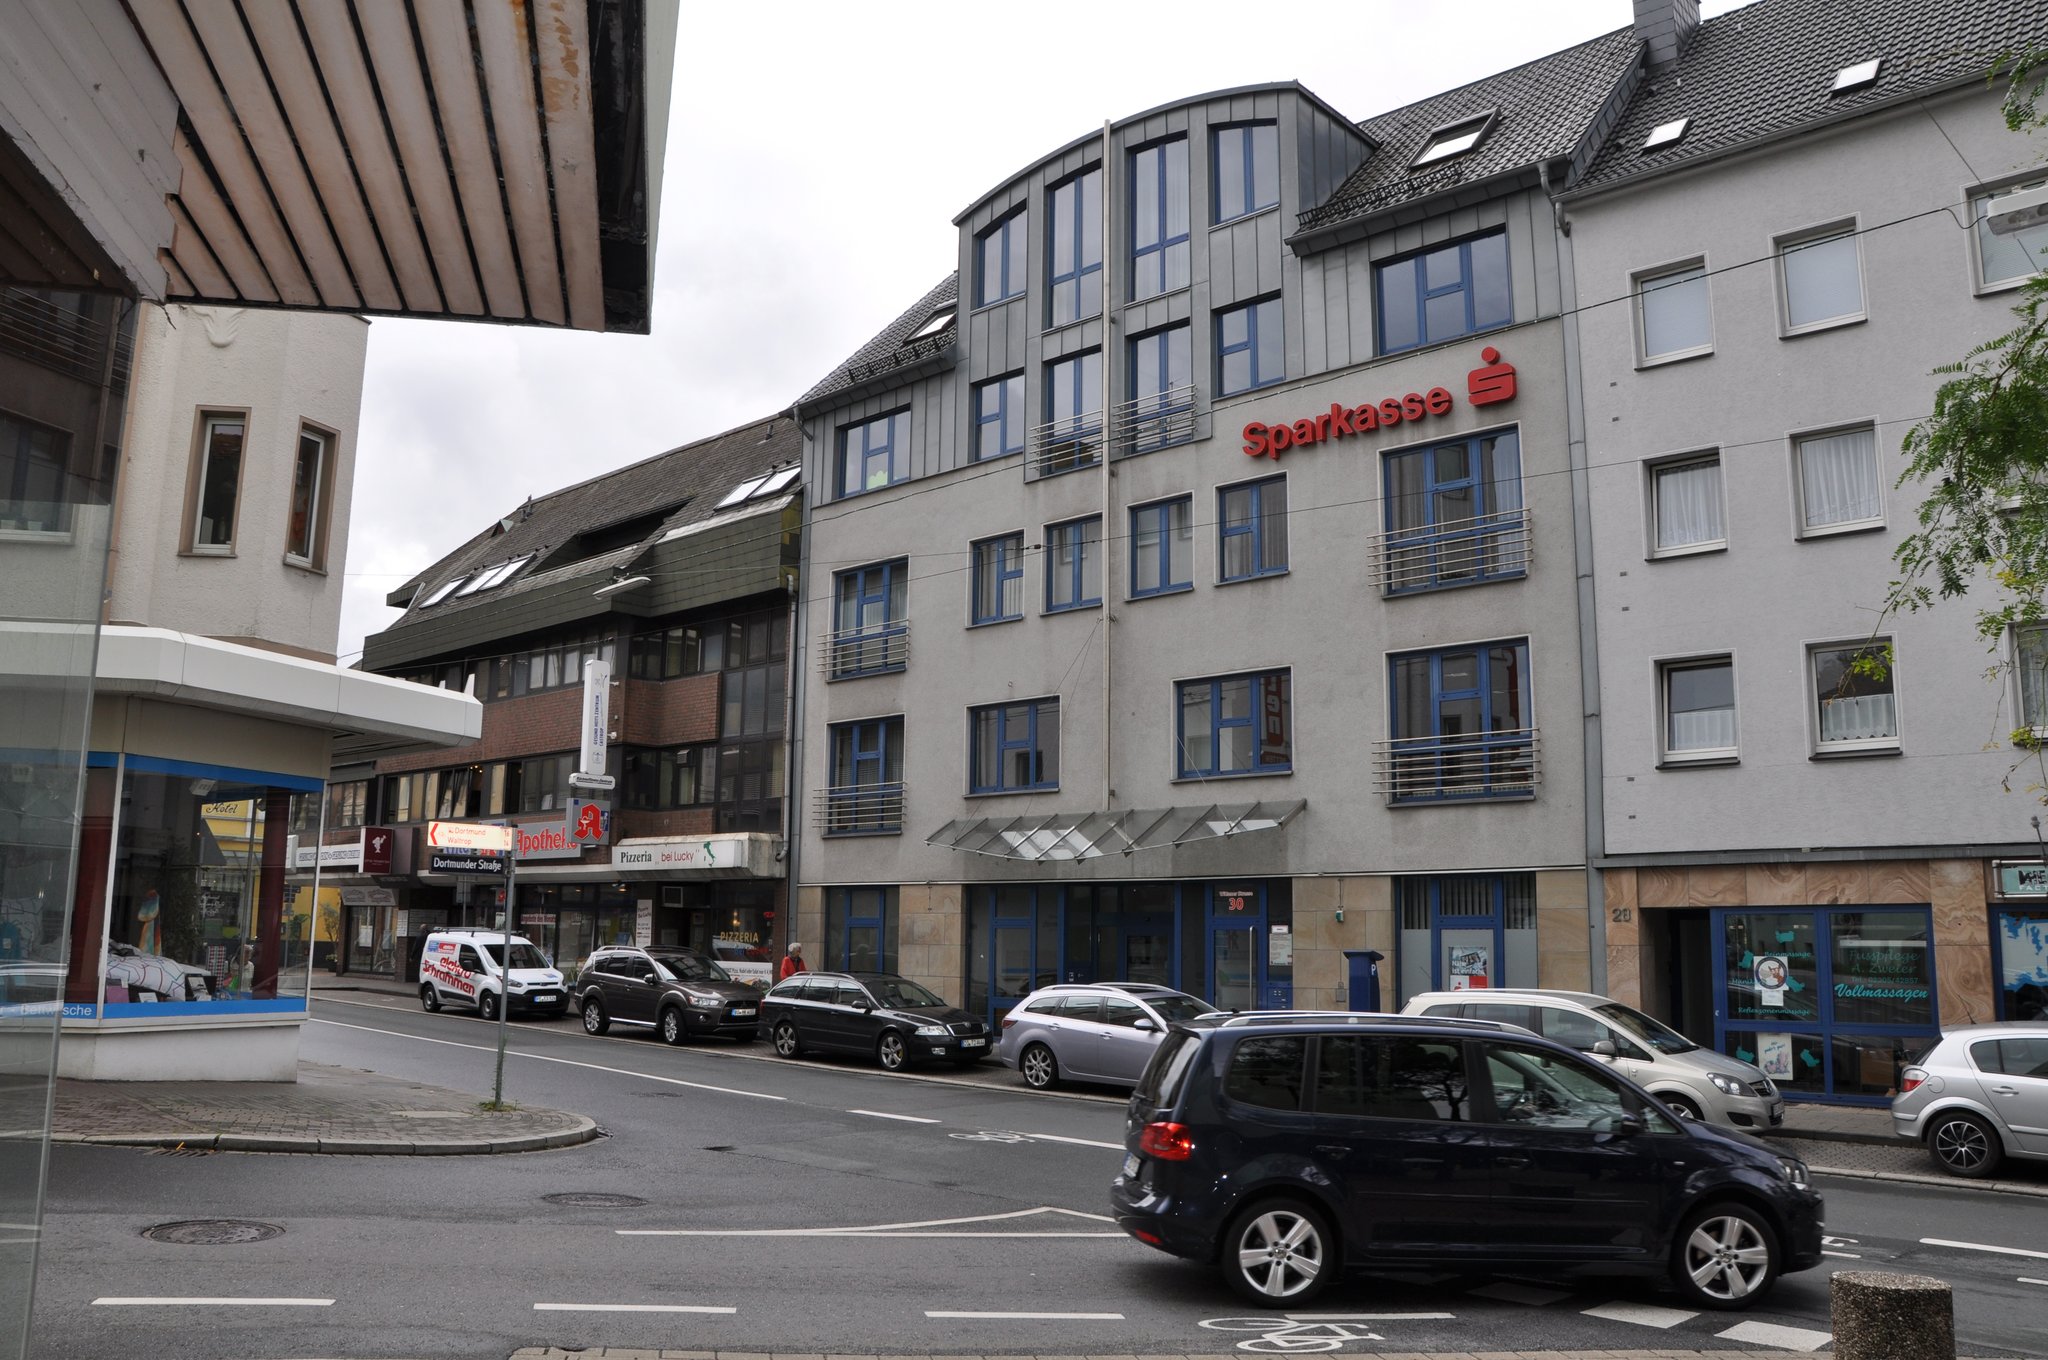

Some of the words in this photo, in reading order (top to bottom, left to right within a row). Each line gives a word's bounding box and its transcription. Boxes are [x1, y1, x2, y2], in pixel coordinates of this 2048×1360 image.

[1242, 386, 1453, 460] Sparkasse
[455, 826, 486, 836] Dortmund
[620, 851, 652, 863] Pizzeria
[661, 852, 673, 862] bei
[674, 850, 695, 863] Lucky
[433, 857, 477, 869] Dortmunder
[478, 859, 502, 873] Straße
[1229, 897, 1244, 911] 30
[720, 932, 759, 943] PIZZERIA
[422, 959, 476, 996] Schrammen
[1834, 983, 1929, 1003] Vollmassagen
